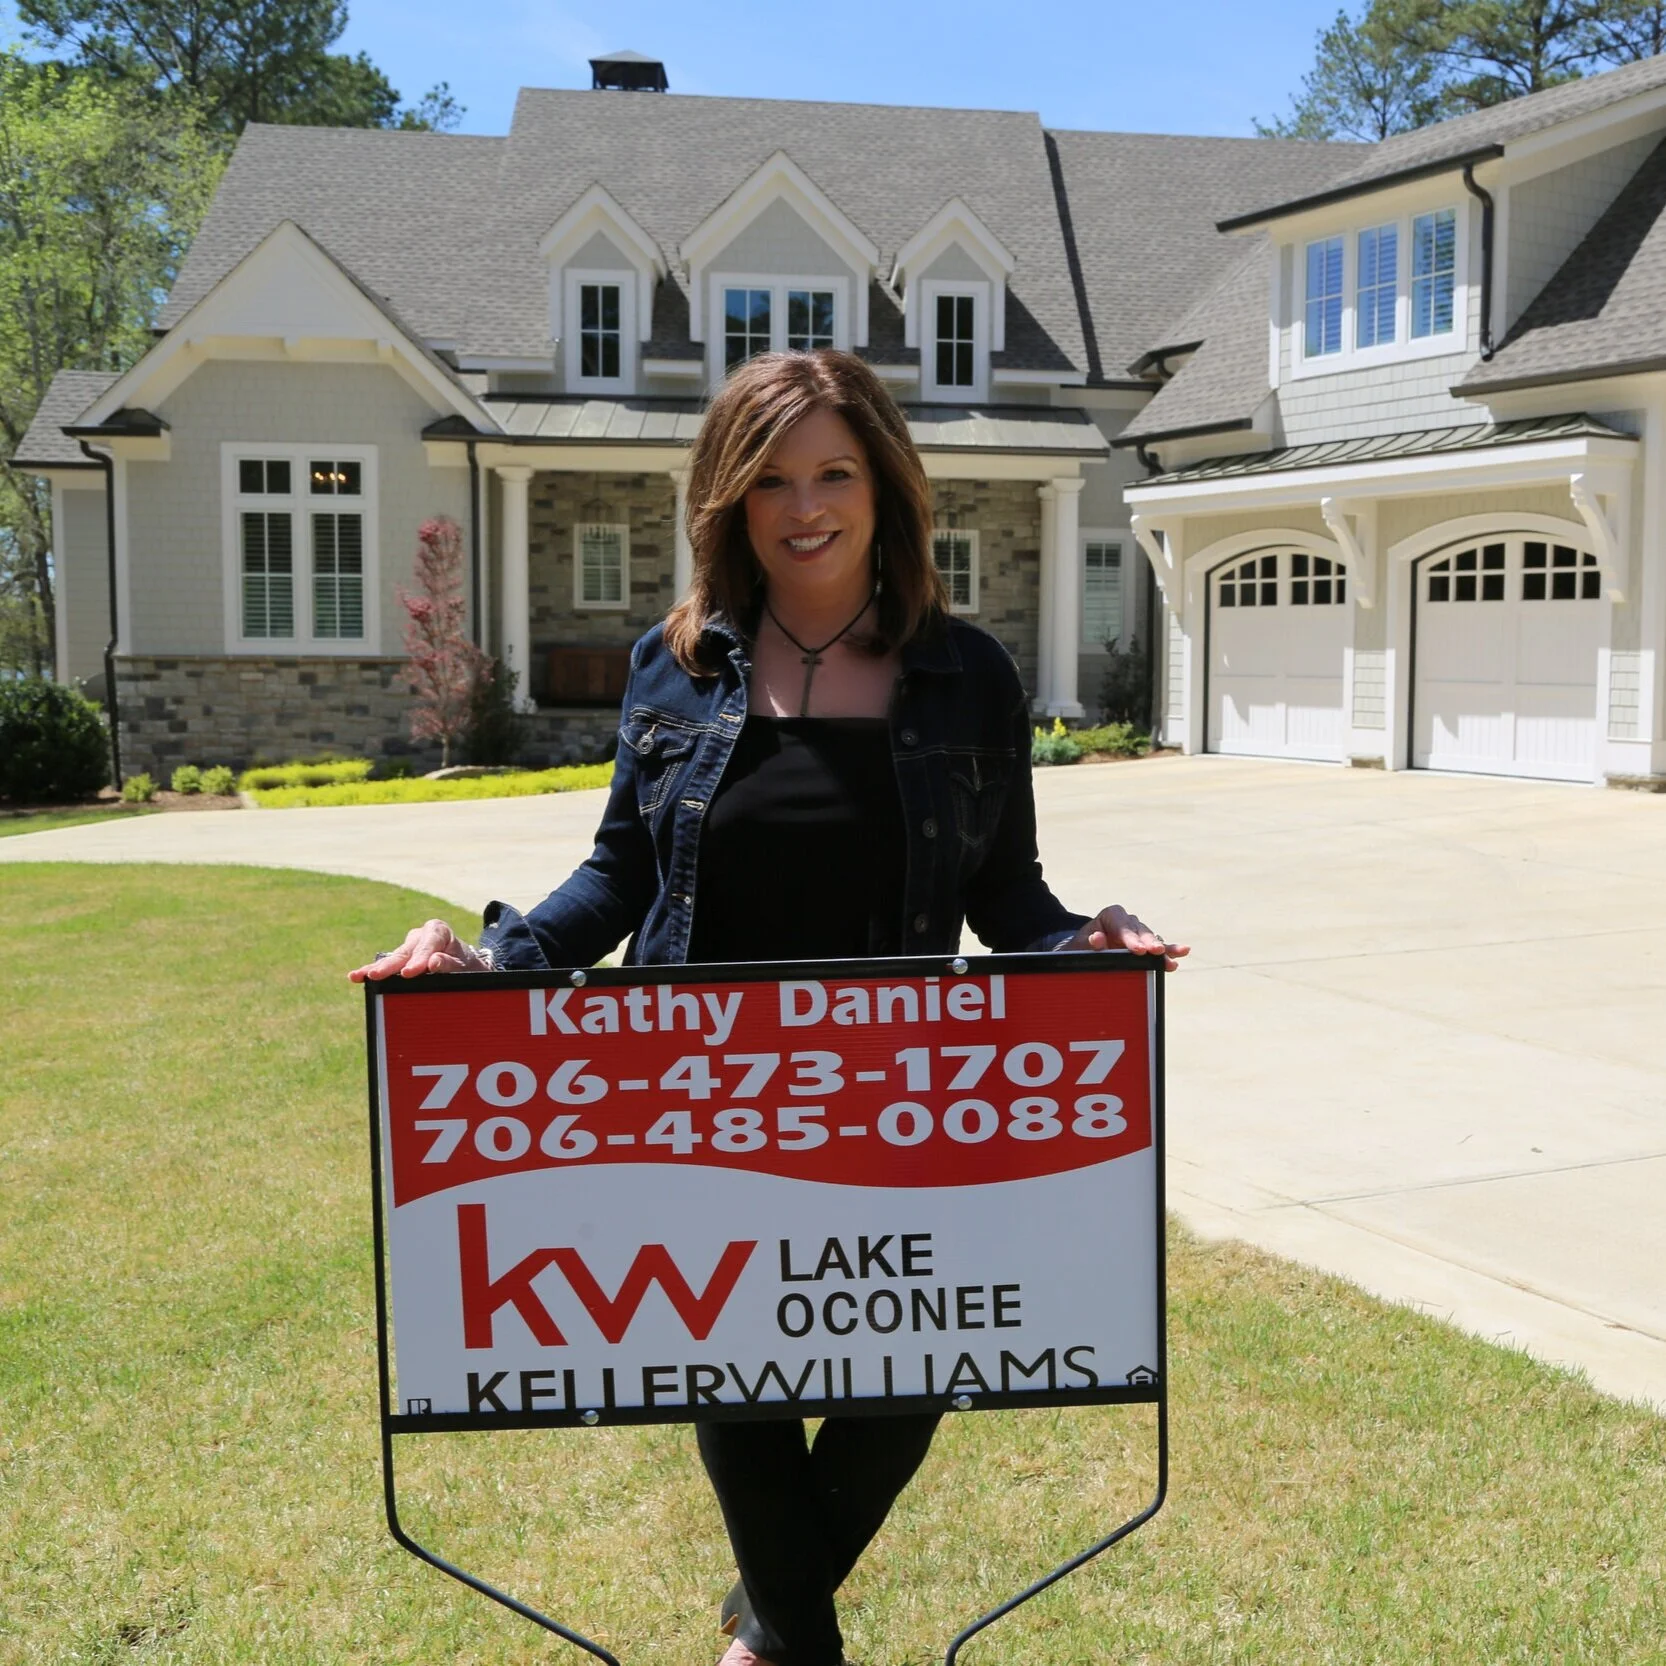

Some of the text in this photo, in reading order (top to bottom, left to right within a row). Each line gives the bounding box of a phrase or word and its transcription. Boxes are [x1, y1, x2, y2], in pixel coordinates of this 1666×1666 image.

[529, 974, 1006, 1045] Kathy Daniel
[412, 1039, 1126, 1109] 706-473-1707
[413, 1094, 1128, 1163] 706-485-0088
[780, 1233, 933, 1281] LAKE
[777, 1284, 1022, 1337] OCONEE
